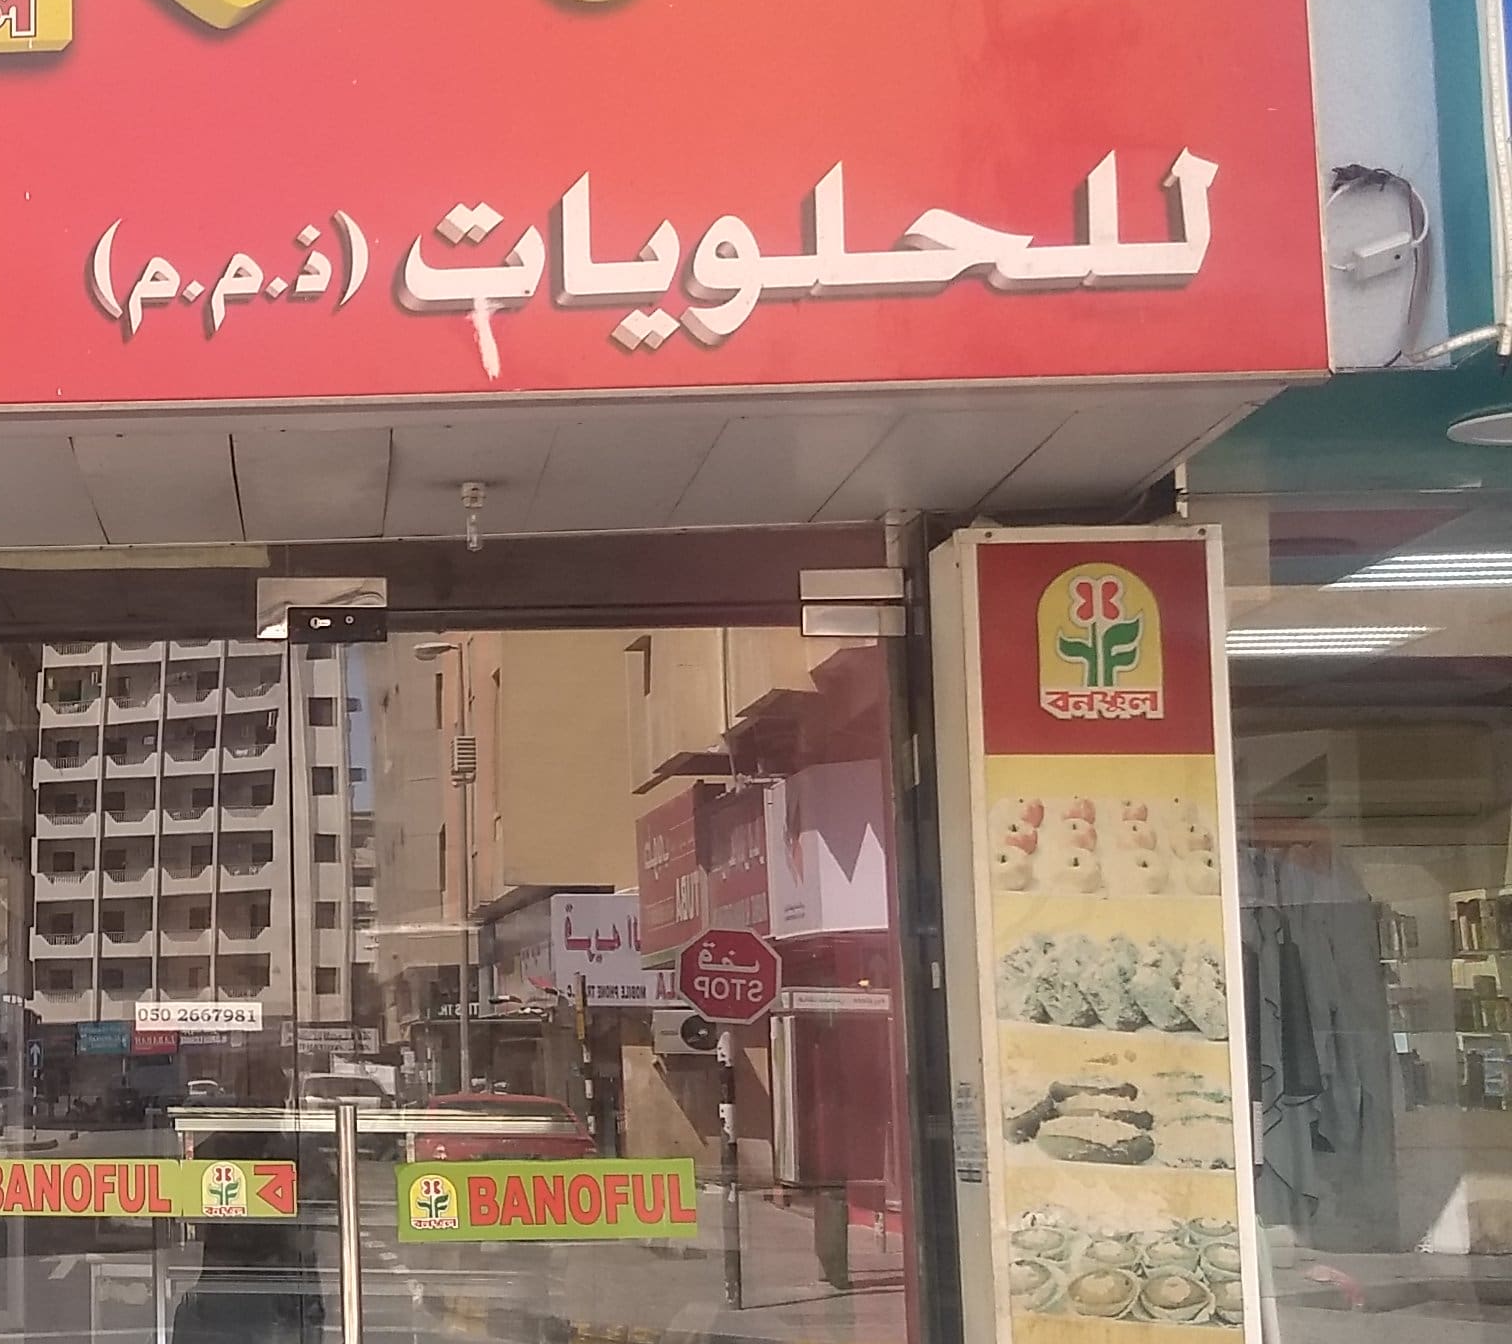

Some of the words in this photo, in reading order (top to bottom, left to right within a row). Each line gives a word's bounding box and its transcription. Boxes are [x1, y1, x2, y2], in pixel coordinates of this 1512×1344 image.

[399, 146, 1221, 354] للحلويات
[1043, 689, 1161, 717] বনফুল
[137, 1007, 171, 1022] 050
[177, 1007, 257, 1023] 2667981
[467, 1173, 696, 1227] BANOFUL
